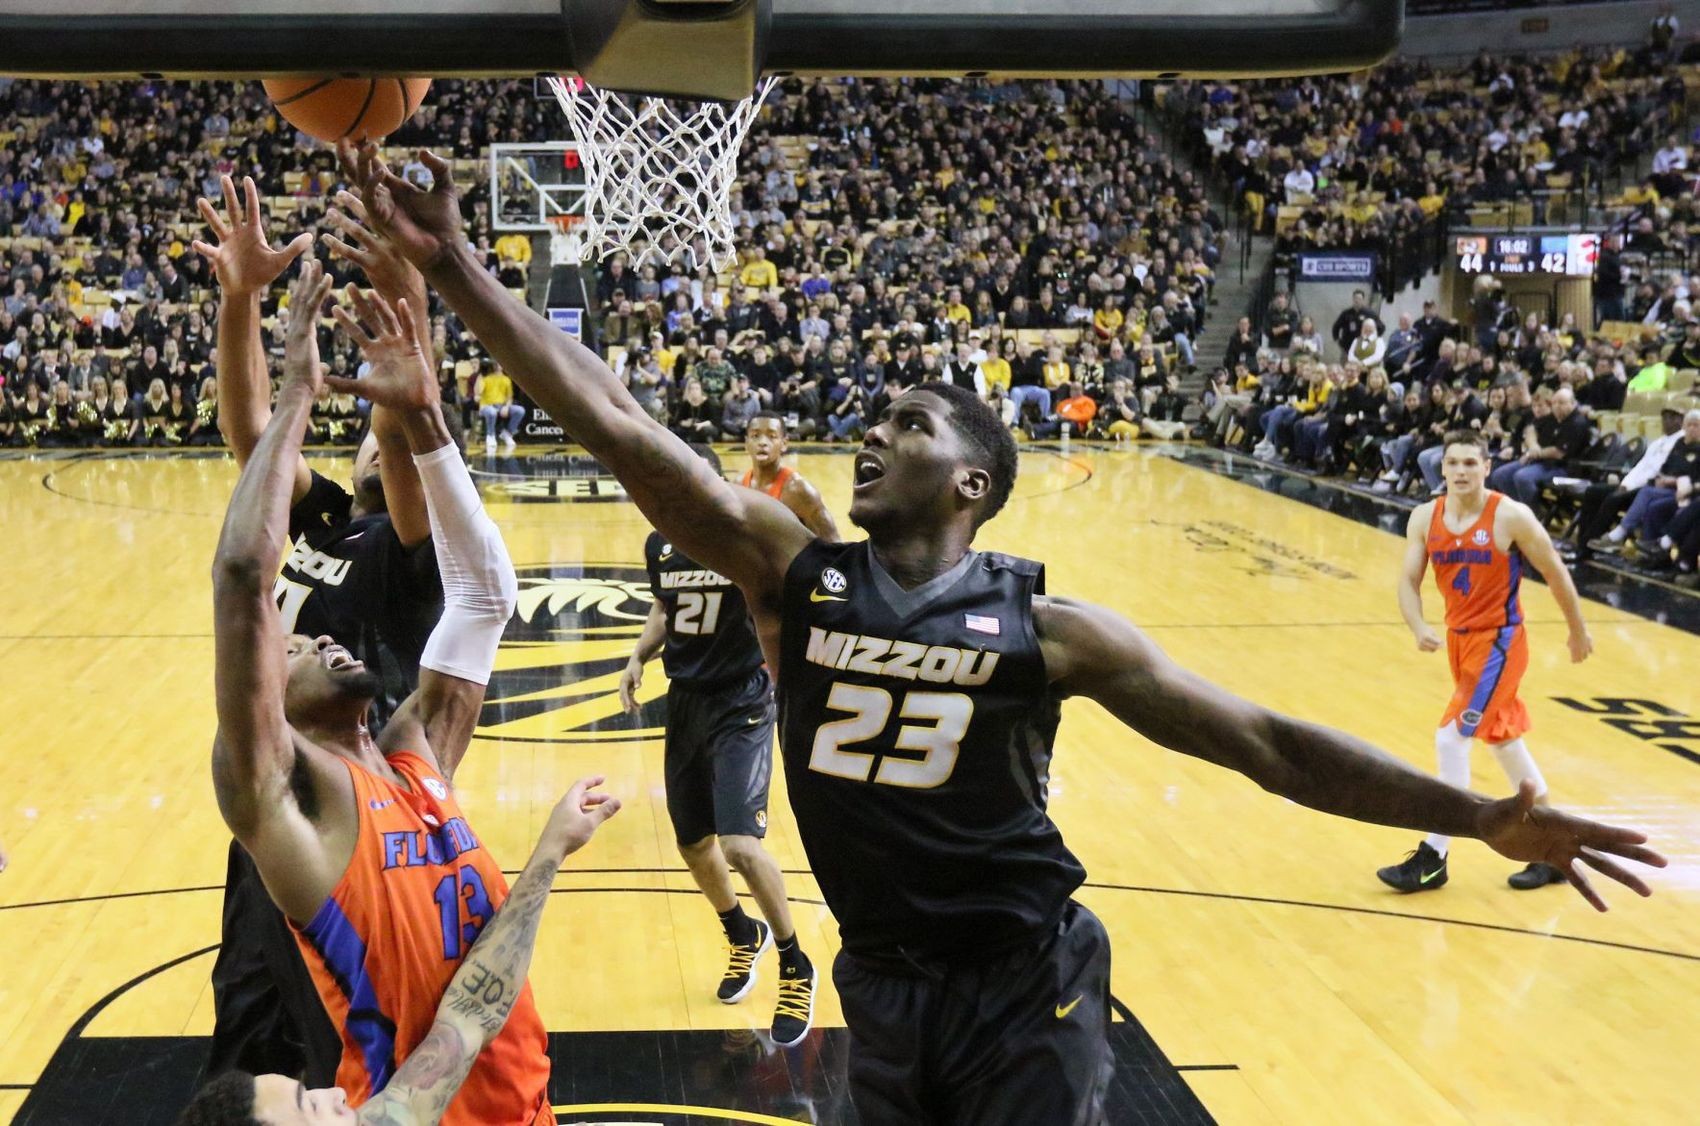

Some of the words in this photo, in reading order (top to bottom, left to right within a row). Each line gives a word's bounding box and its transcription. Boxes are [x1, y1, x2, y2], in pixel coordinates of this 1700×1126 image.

[1460, 253, 1483, 273] 44
[1541, 253, 1565, 273] 42
[823, 569, 846, 591] SEC
[1452, 567, 1471, 596] 4
[674, 592, 723, 635] 21
[805, 625, 1000, 686] MIZZOU
[808, 681, 975, 790] 23
[433, 864, 496, 961] 13
